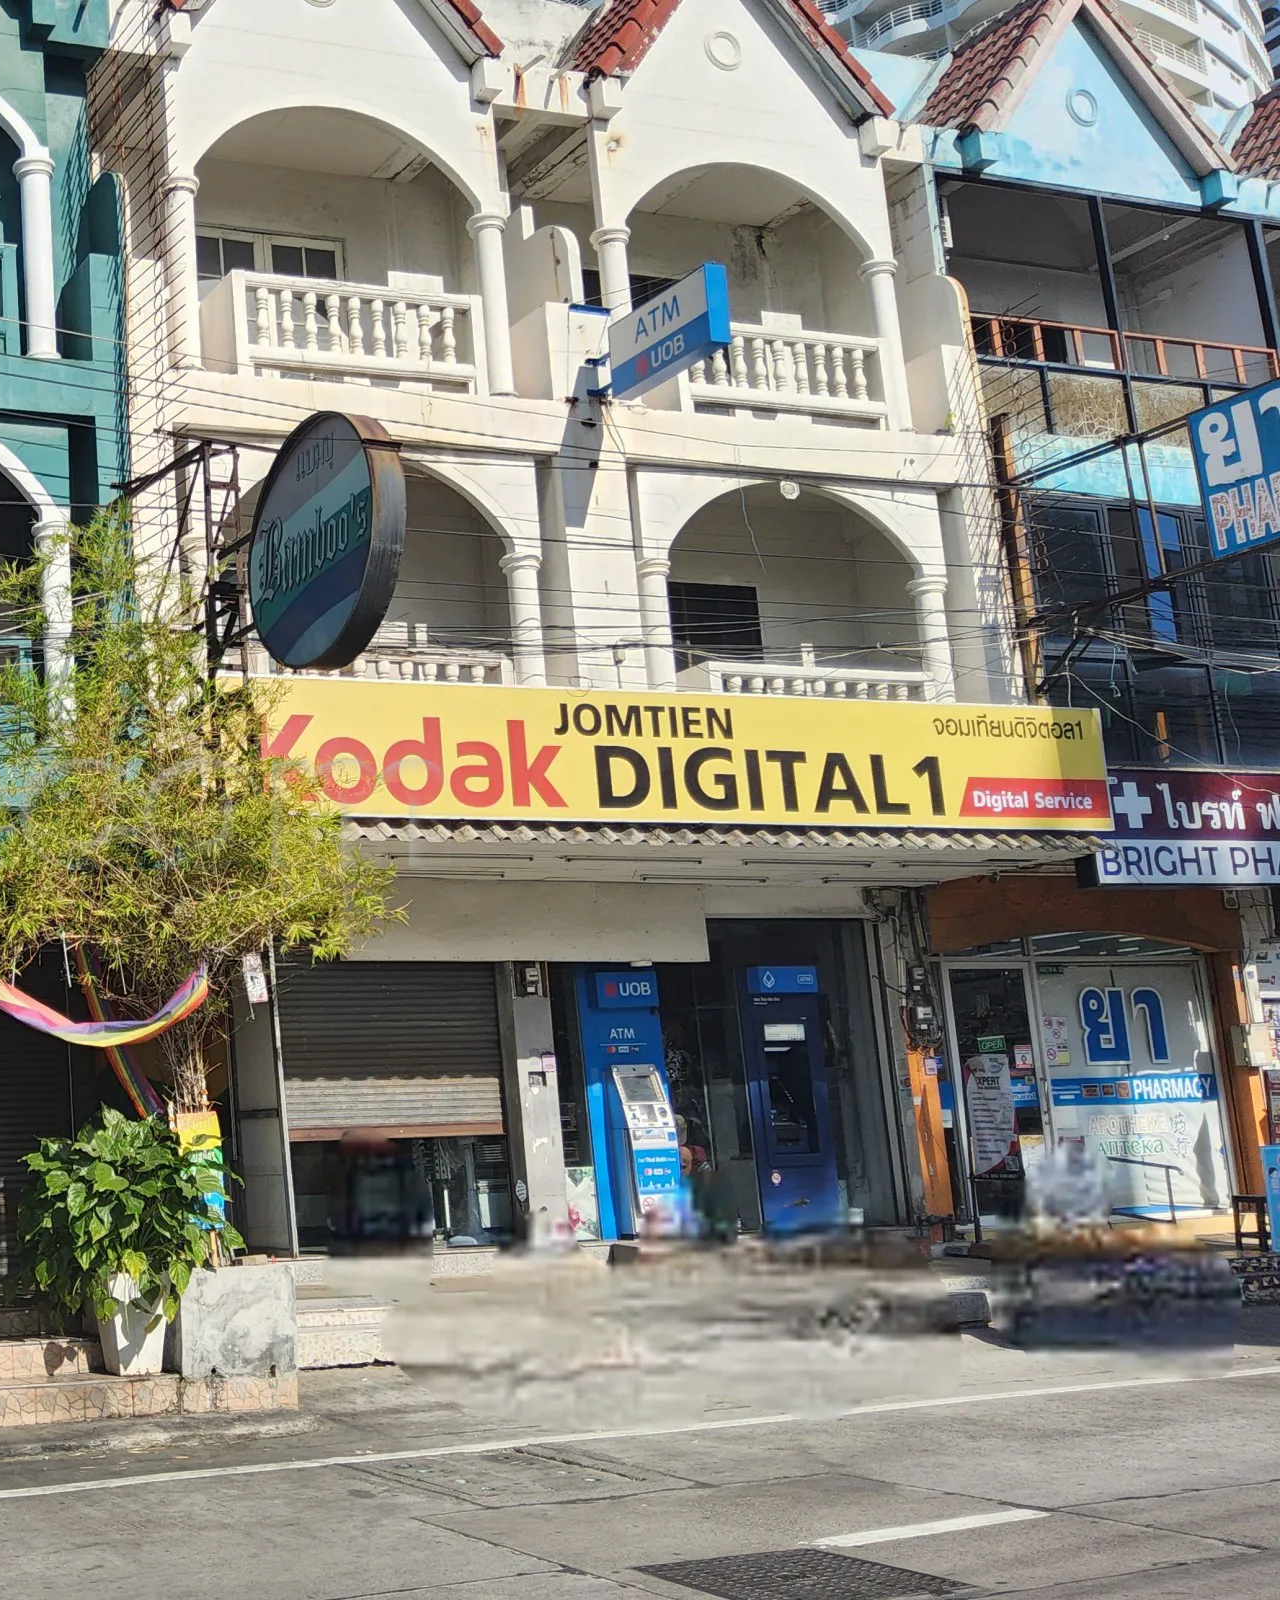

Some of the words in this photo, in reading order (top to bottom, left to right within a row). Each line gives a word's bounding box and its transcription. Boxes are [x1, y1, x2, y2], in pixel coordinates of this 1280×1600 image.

[634, 295, 681, 344] ATM
[650, 334, 685, 368] UOB
[258, 492, 368, 622] Bamboo's
[554, 702, 734, 739] JOMTIEN
[259, 714, 568, 808] Kodak
[973, 790, 1028, 812] Digital
[1035, 792, 1093, 809] Service
[1155, 782, 1247, 830] ไบรท์
[1101, 846, 1218, 876] BRIGHT
[1228, 846, 1280, 876] PH
[619, 982, 651, 996] UOB
[610, 1028, 635, 1039] ATM
[1078, 986, 1170, 1065] ยา
[981, 1040, 1004, 1050] OPEN
[1133, 1077, 1211, 1100] PHARMACY
